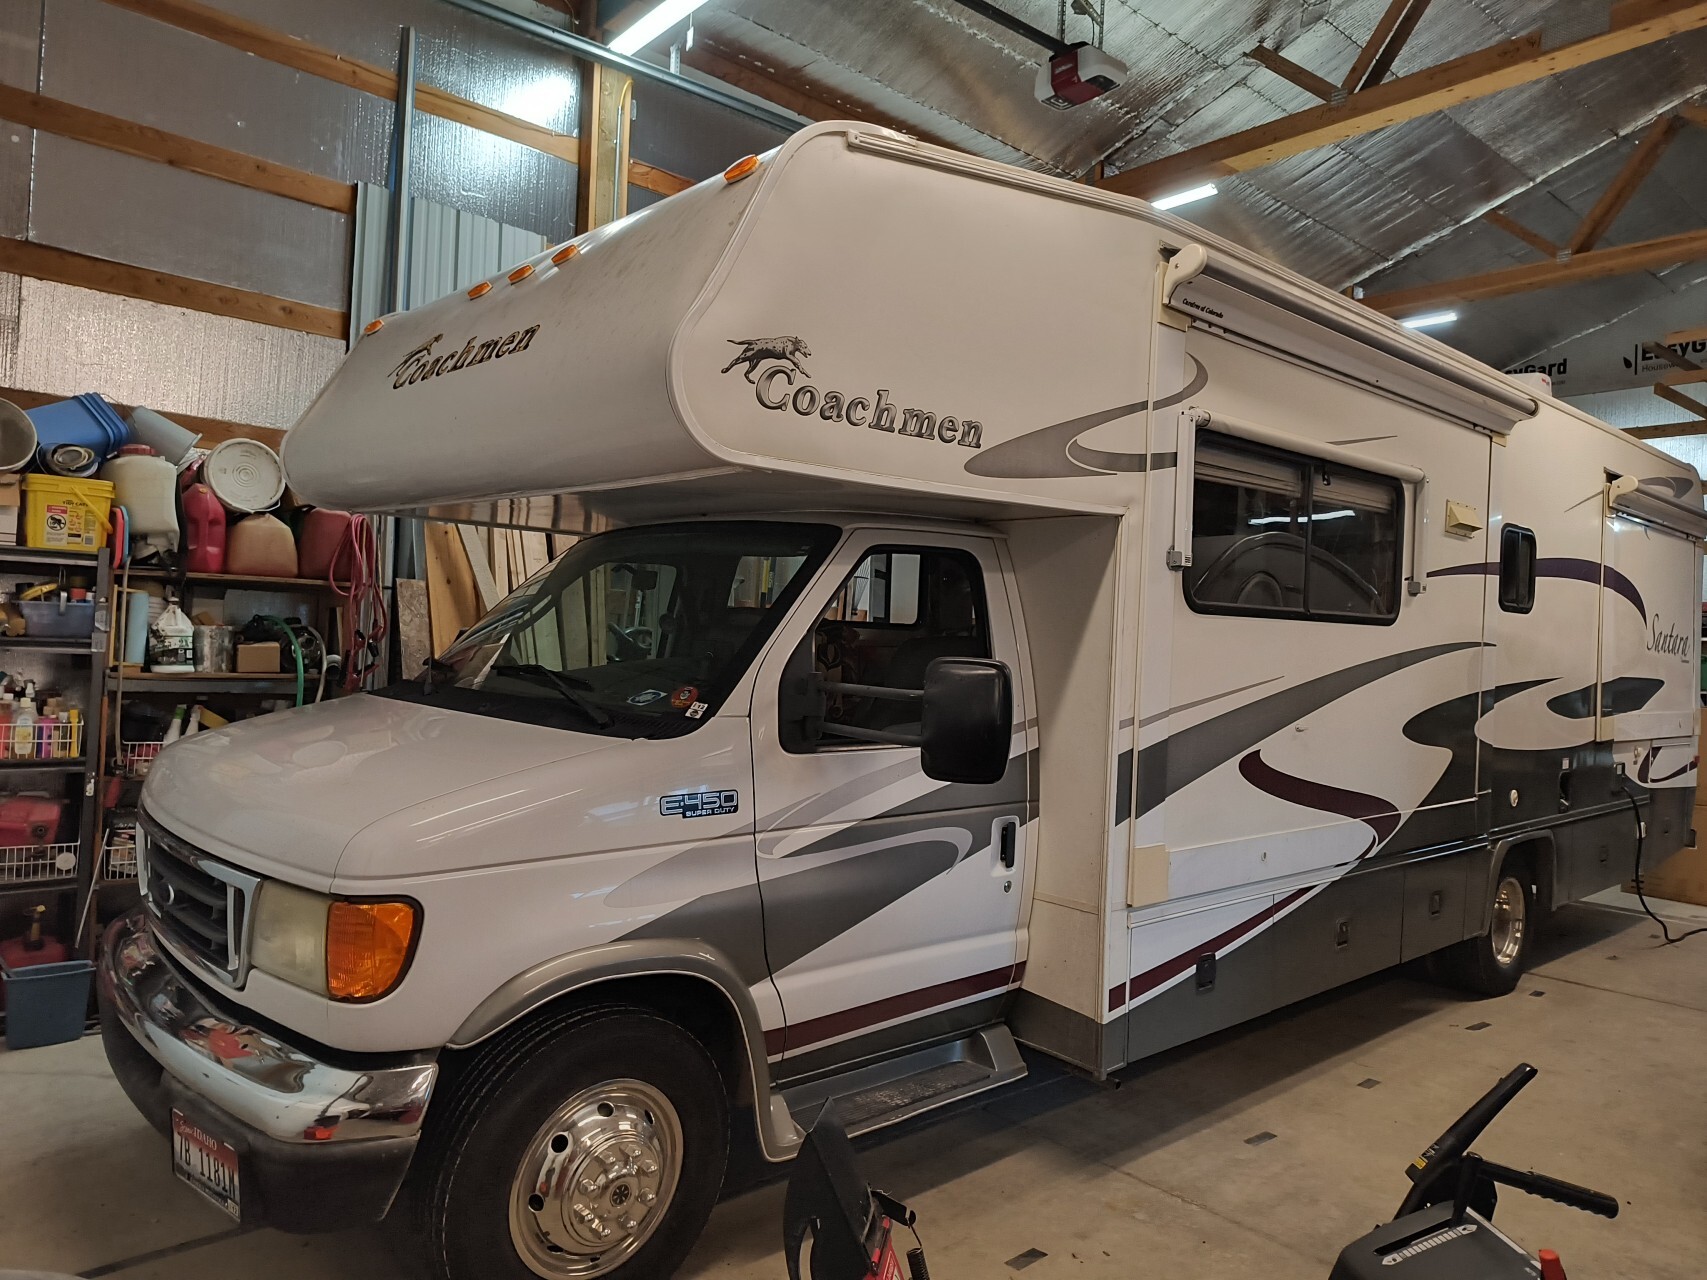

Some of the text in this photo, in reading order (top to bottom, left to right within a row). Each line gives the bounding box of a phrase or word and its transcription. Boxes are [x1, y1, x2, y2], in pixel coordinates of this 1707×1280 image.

[392, 324, 541, 390] Coachmen
[755, 365, 984, 449] Coachmen
[1646, 612, 1690, 657] Santara
[685, 806, 735, 817] SUPER DUTY
[193, 1127, 217, 1151] IDAHO
